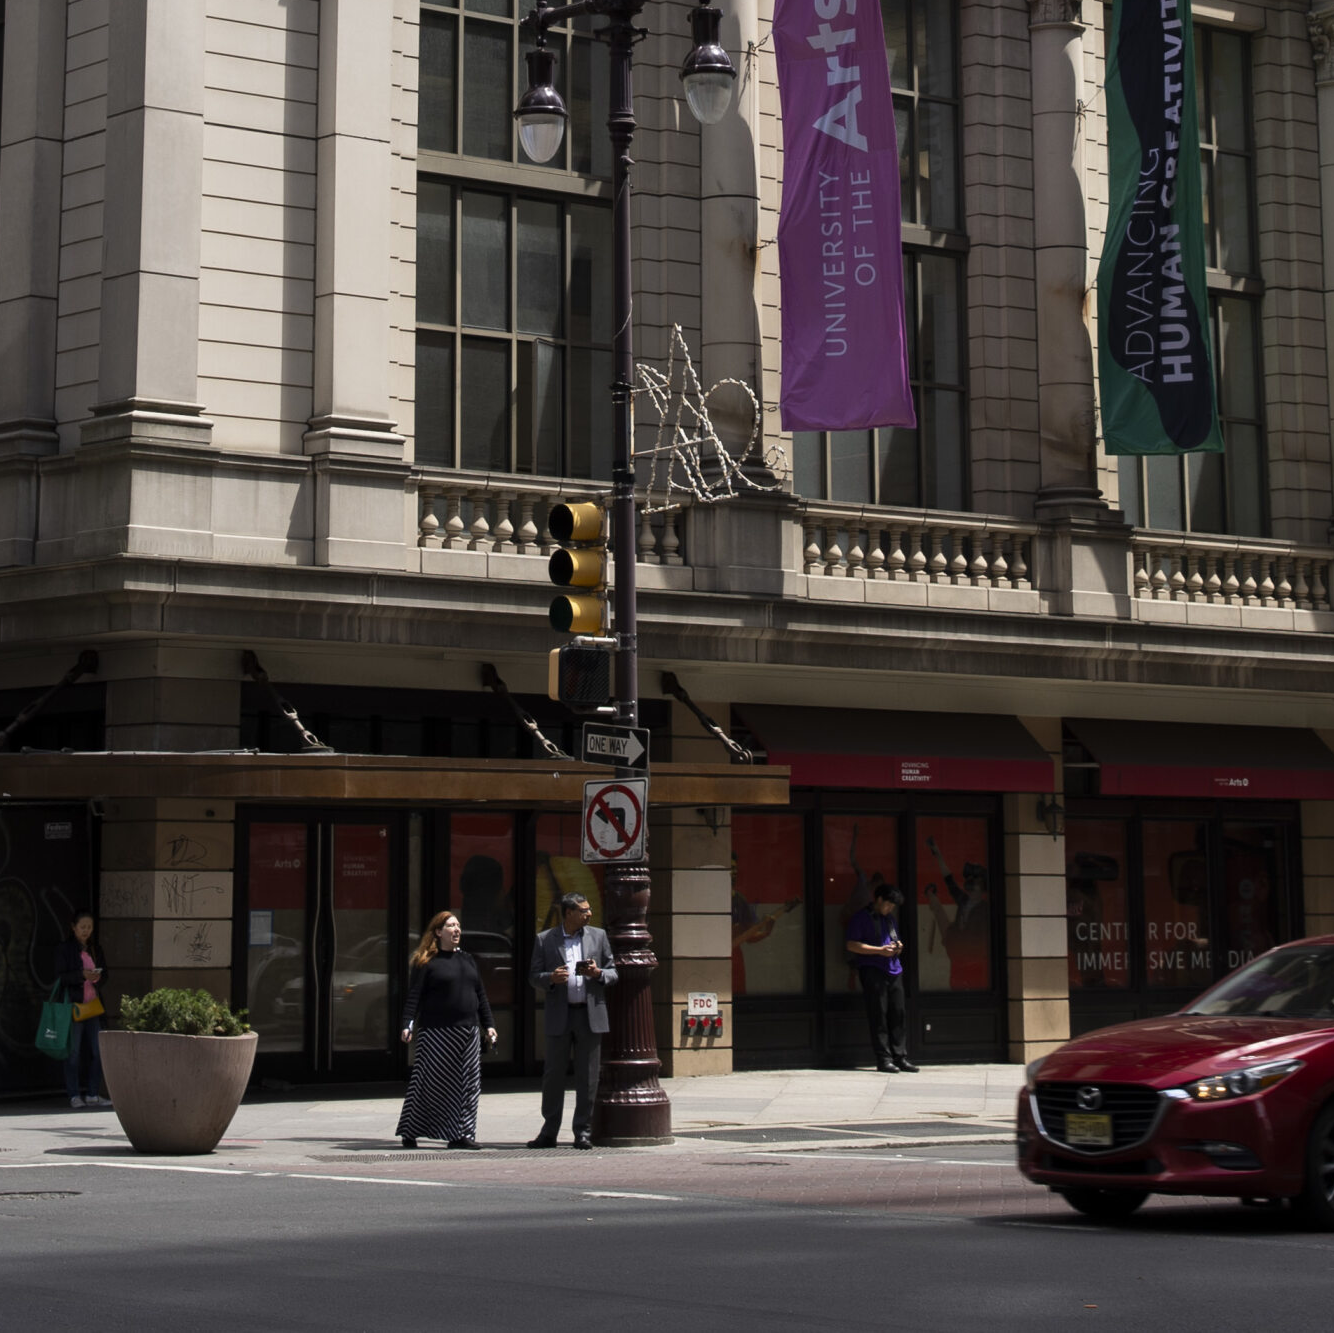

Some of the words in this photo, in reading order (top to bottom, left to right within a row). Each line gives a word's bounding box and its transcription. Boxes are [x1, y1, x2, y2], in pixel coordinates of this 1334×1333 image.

[850, 169, 873, 232] THE
[819, 170, 847, 357] UNIVERSITY
[855, 245, 877, 286] OF
[1125, 148, 1160, 384] ADVANCING
[1159, 224, 1194, 384] HUMAN
[589, 736, 606, 752] ONE
[609, 738, 628, 754] WAY
[1165, 922, 1198, 941] FOR
[693, 998, 712, 1008] FDC
